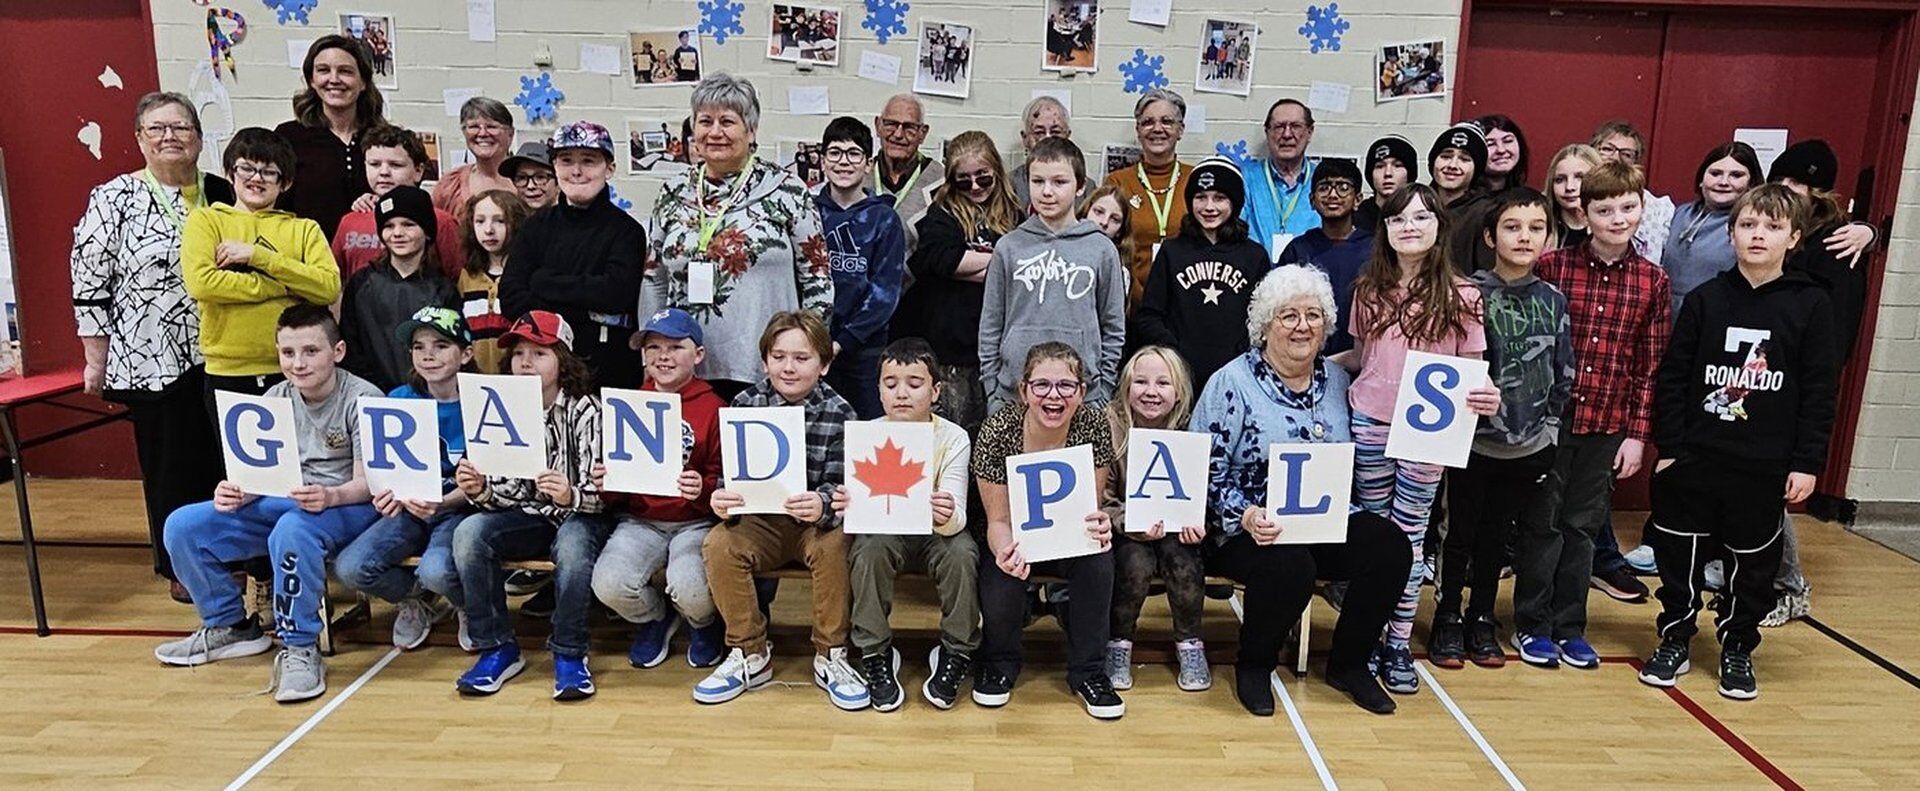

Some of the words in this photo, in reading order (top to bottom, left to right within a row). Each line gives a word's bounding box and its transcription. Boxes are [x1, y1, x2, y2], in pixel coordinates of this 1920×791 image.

[1176, 261, 1248, 295] CONVERSE
[1704, 364, 1784, 391] RONALDO
[1724, 326, 1772, 368] 7
[468, 386, 530, 448] A
[1405, 362, 1461, 433] S
[225, 402, 284, 467] G
[363, 406, 428, 471] R
[606, 397, 672, 464] N
[727, 420, 790, 481] D
[1016, 460, 1077, 531] P
[1129, 440, 1191, 501] A
[1276, 452, 1331, 516] L
